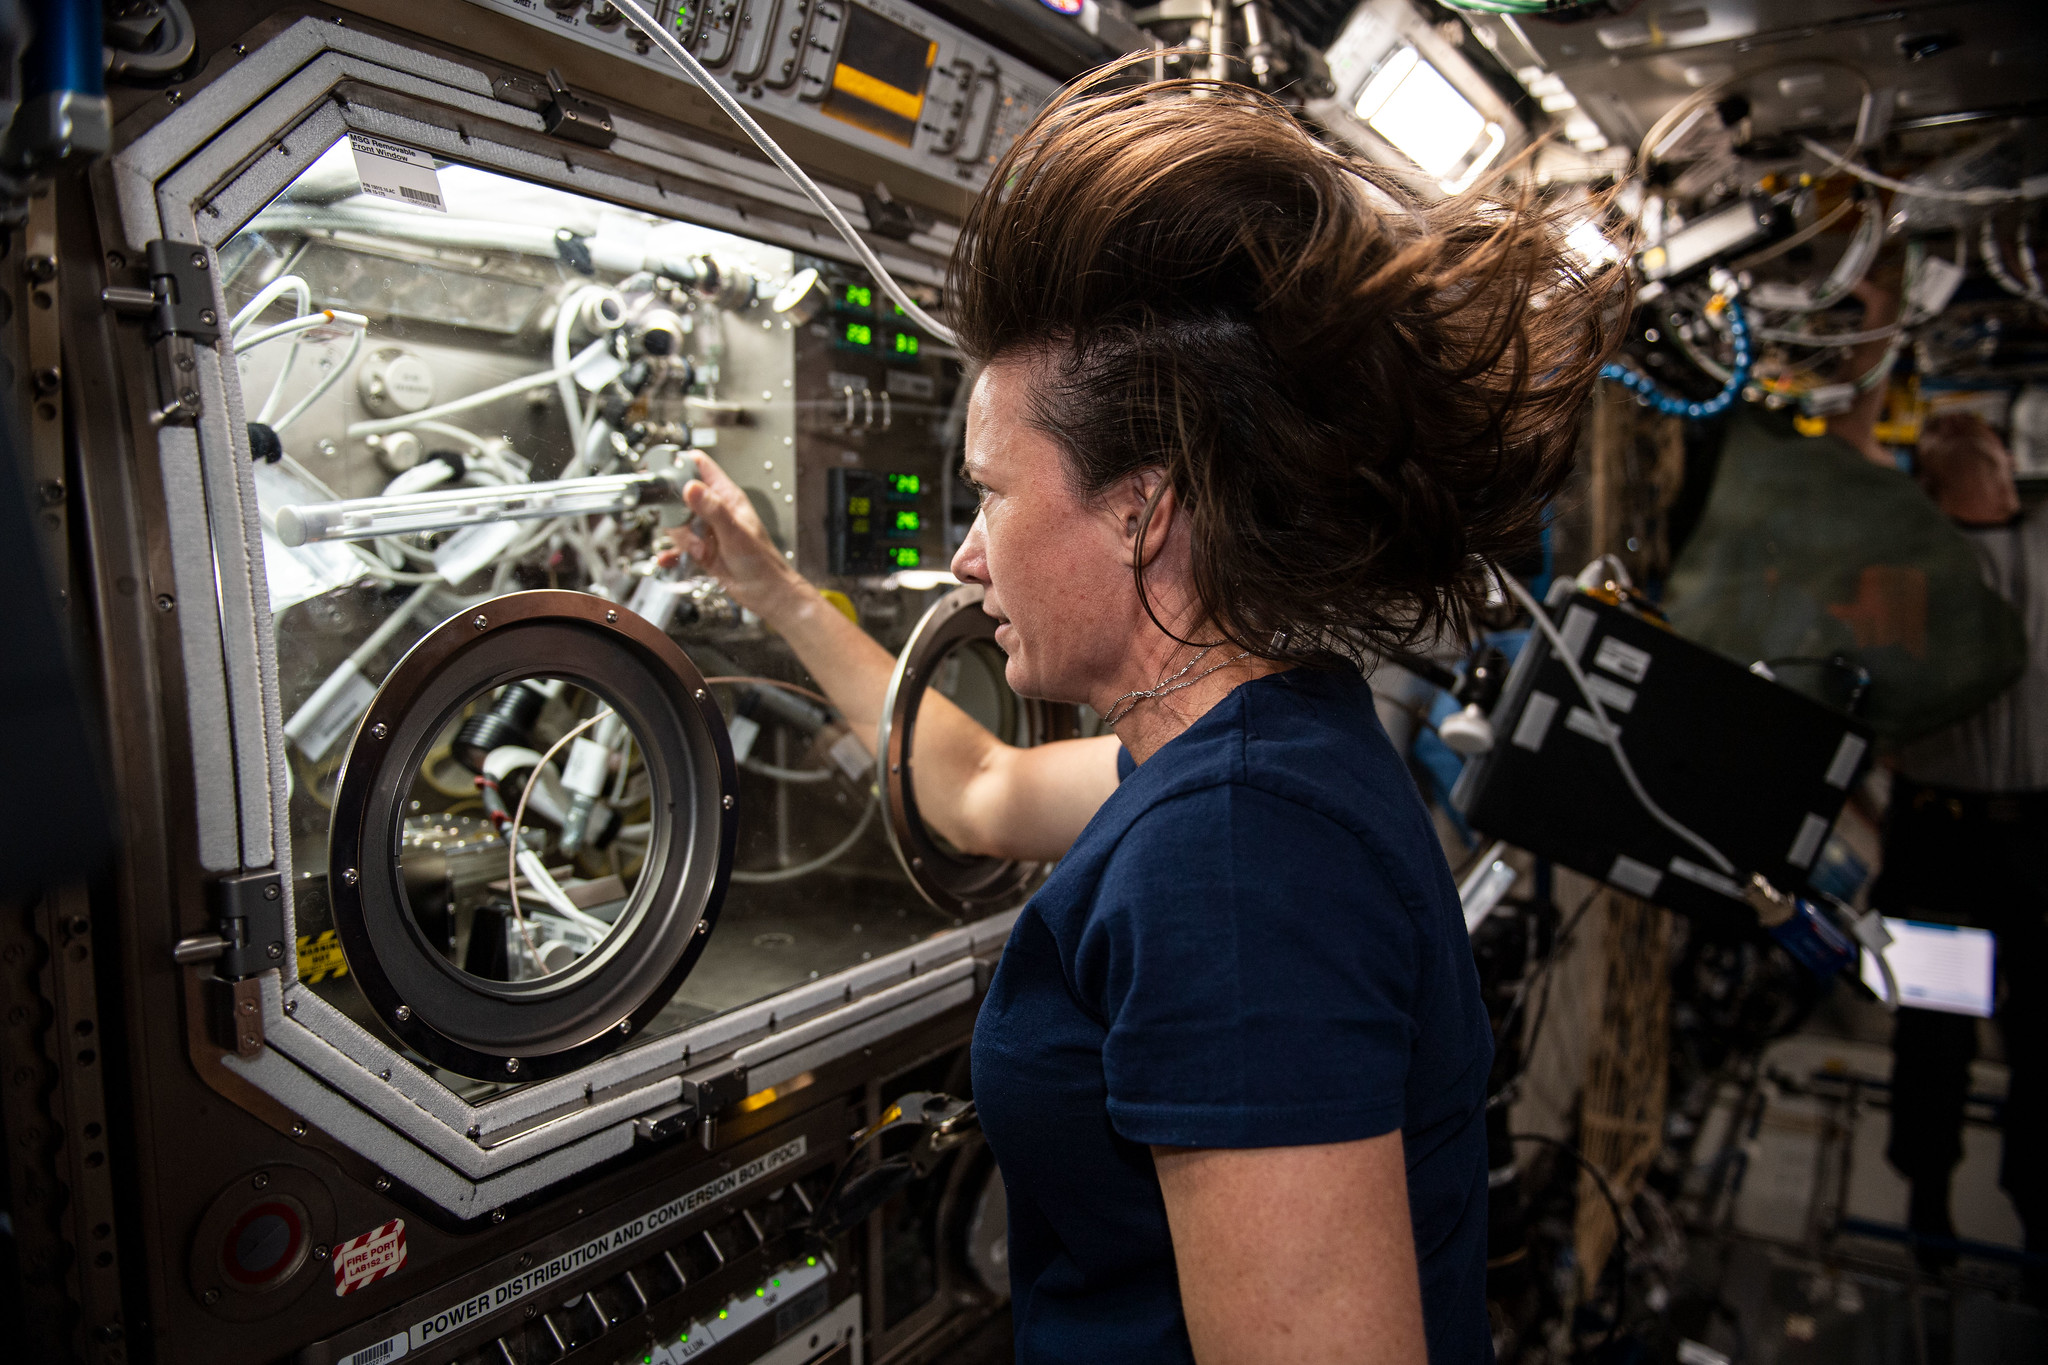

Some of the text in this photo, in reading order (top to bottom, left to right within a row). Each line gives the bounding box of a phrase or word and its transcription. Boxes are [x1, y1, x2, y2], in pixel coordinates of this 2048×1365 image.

[574, 18, 579, 26] 2
[349, 133, 416, 157] MSG Removable
[352, 141, 408, 161] Front Window
[346, 1240, 396, 1267] FIRE PORT
[422, 1294, 490, 1340] POWER
[495, 1239, 609, 1305] DISTRIBUTION
[612, 1220, 644, 1247] AND
[648, 1174, 736, 1229] CONVERSION
[739, 1161, 765, 1182] BOX
[350, 1252, 394, 1276] LAB1S2_E1
